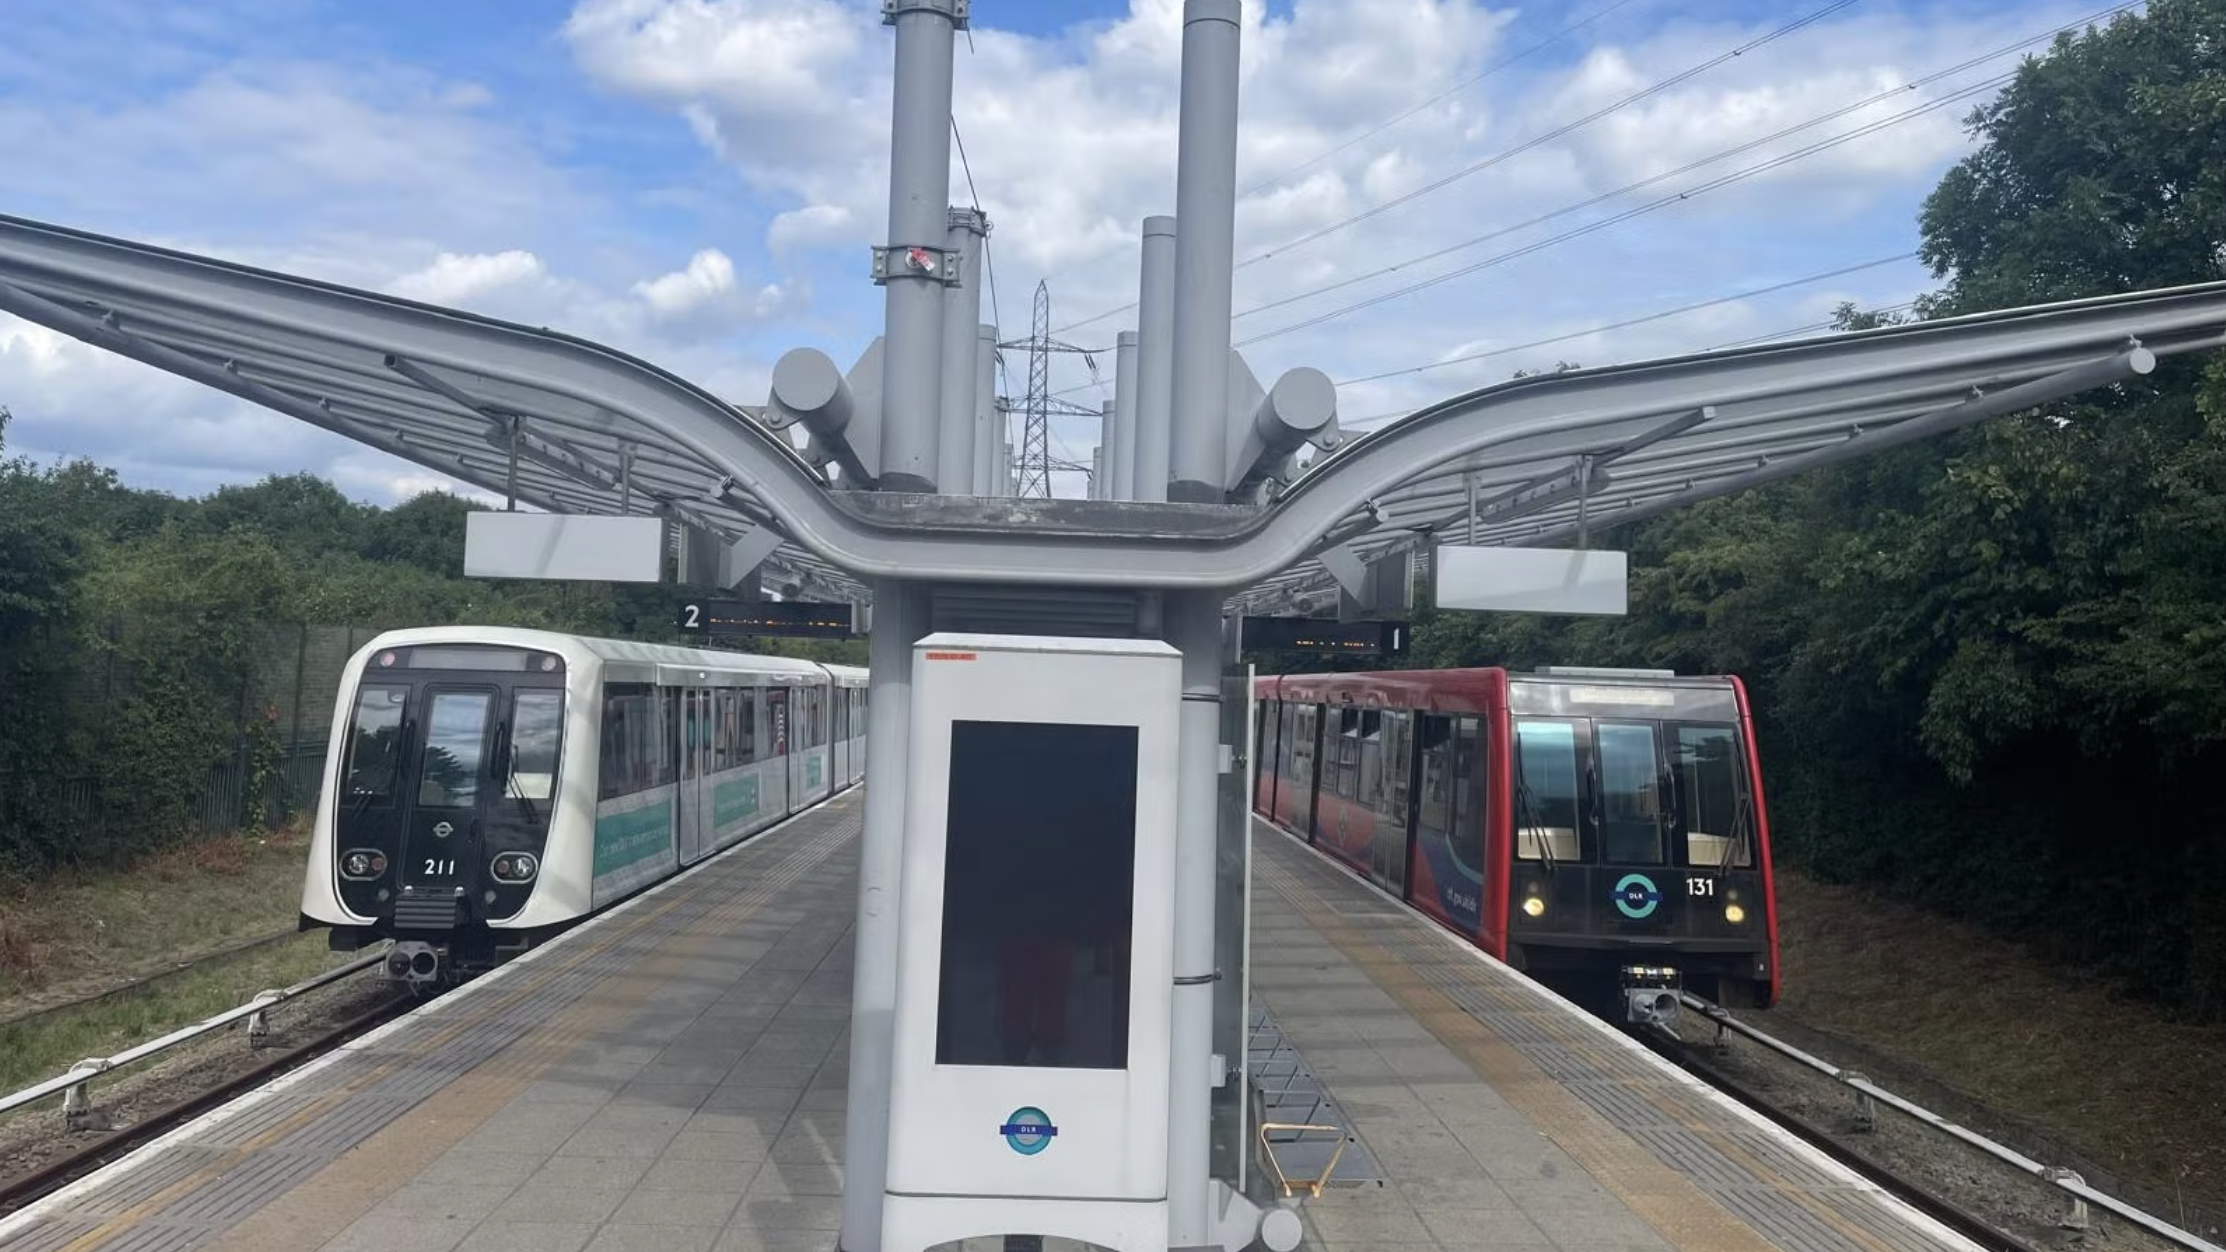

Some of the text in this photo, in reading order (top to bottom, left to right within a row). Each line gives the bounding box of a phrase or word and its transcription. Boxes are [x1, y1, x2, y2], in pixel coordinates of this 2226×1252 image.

[685, 604, 699, 627] 2
[1393, 627, 1399, 650] 1
[424, 858, 455, 876] 211
[1628, 892, 1643, 900] DLR
[1686, 877, 1714, 896] 131
